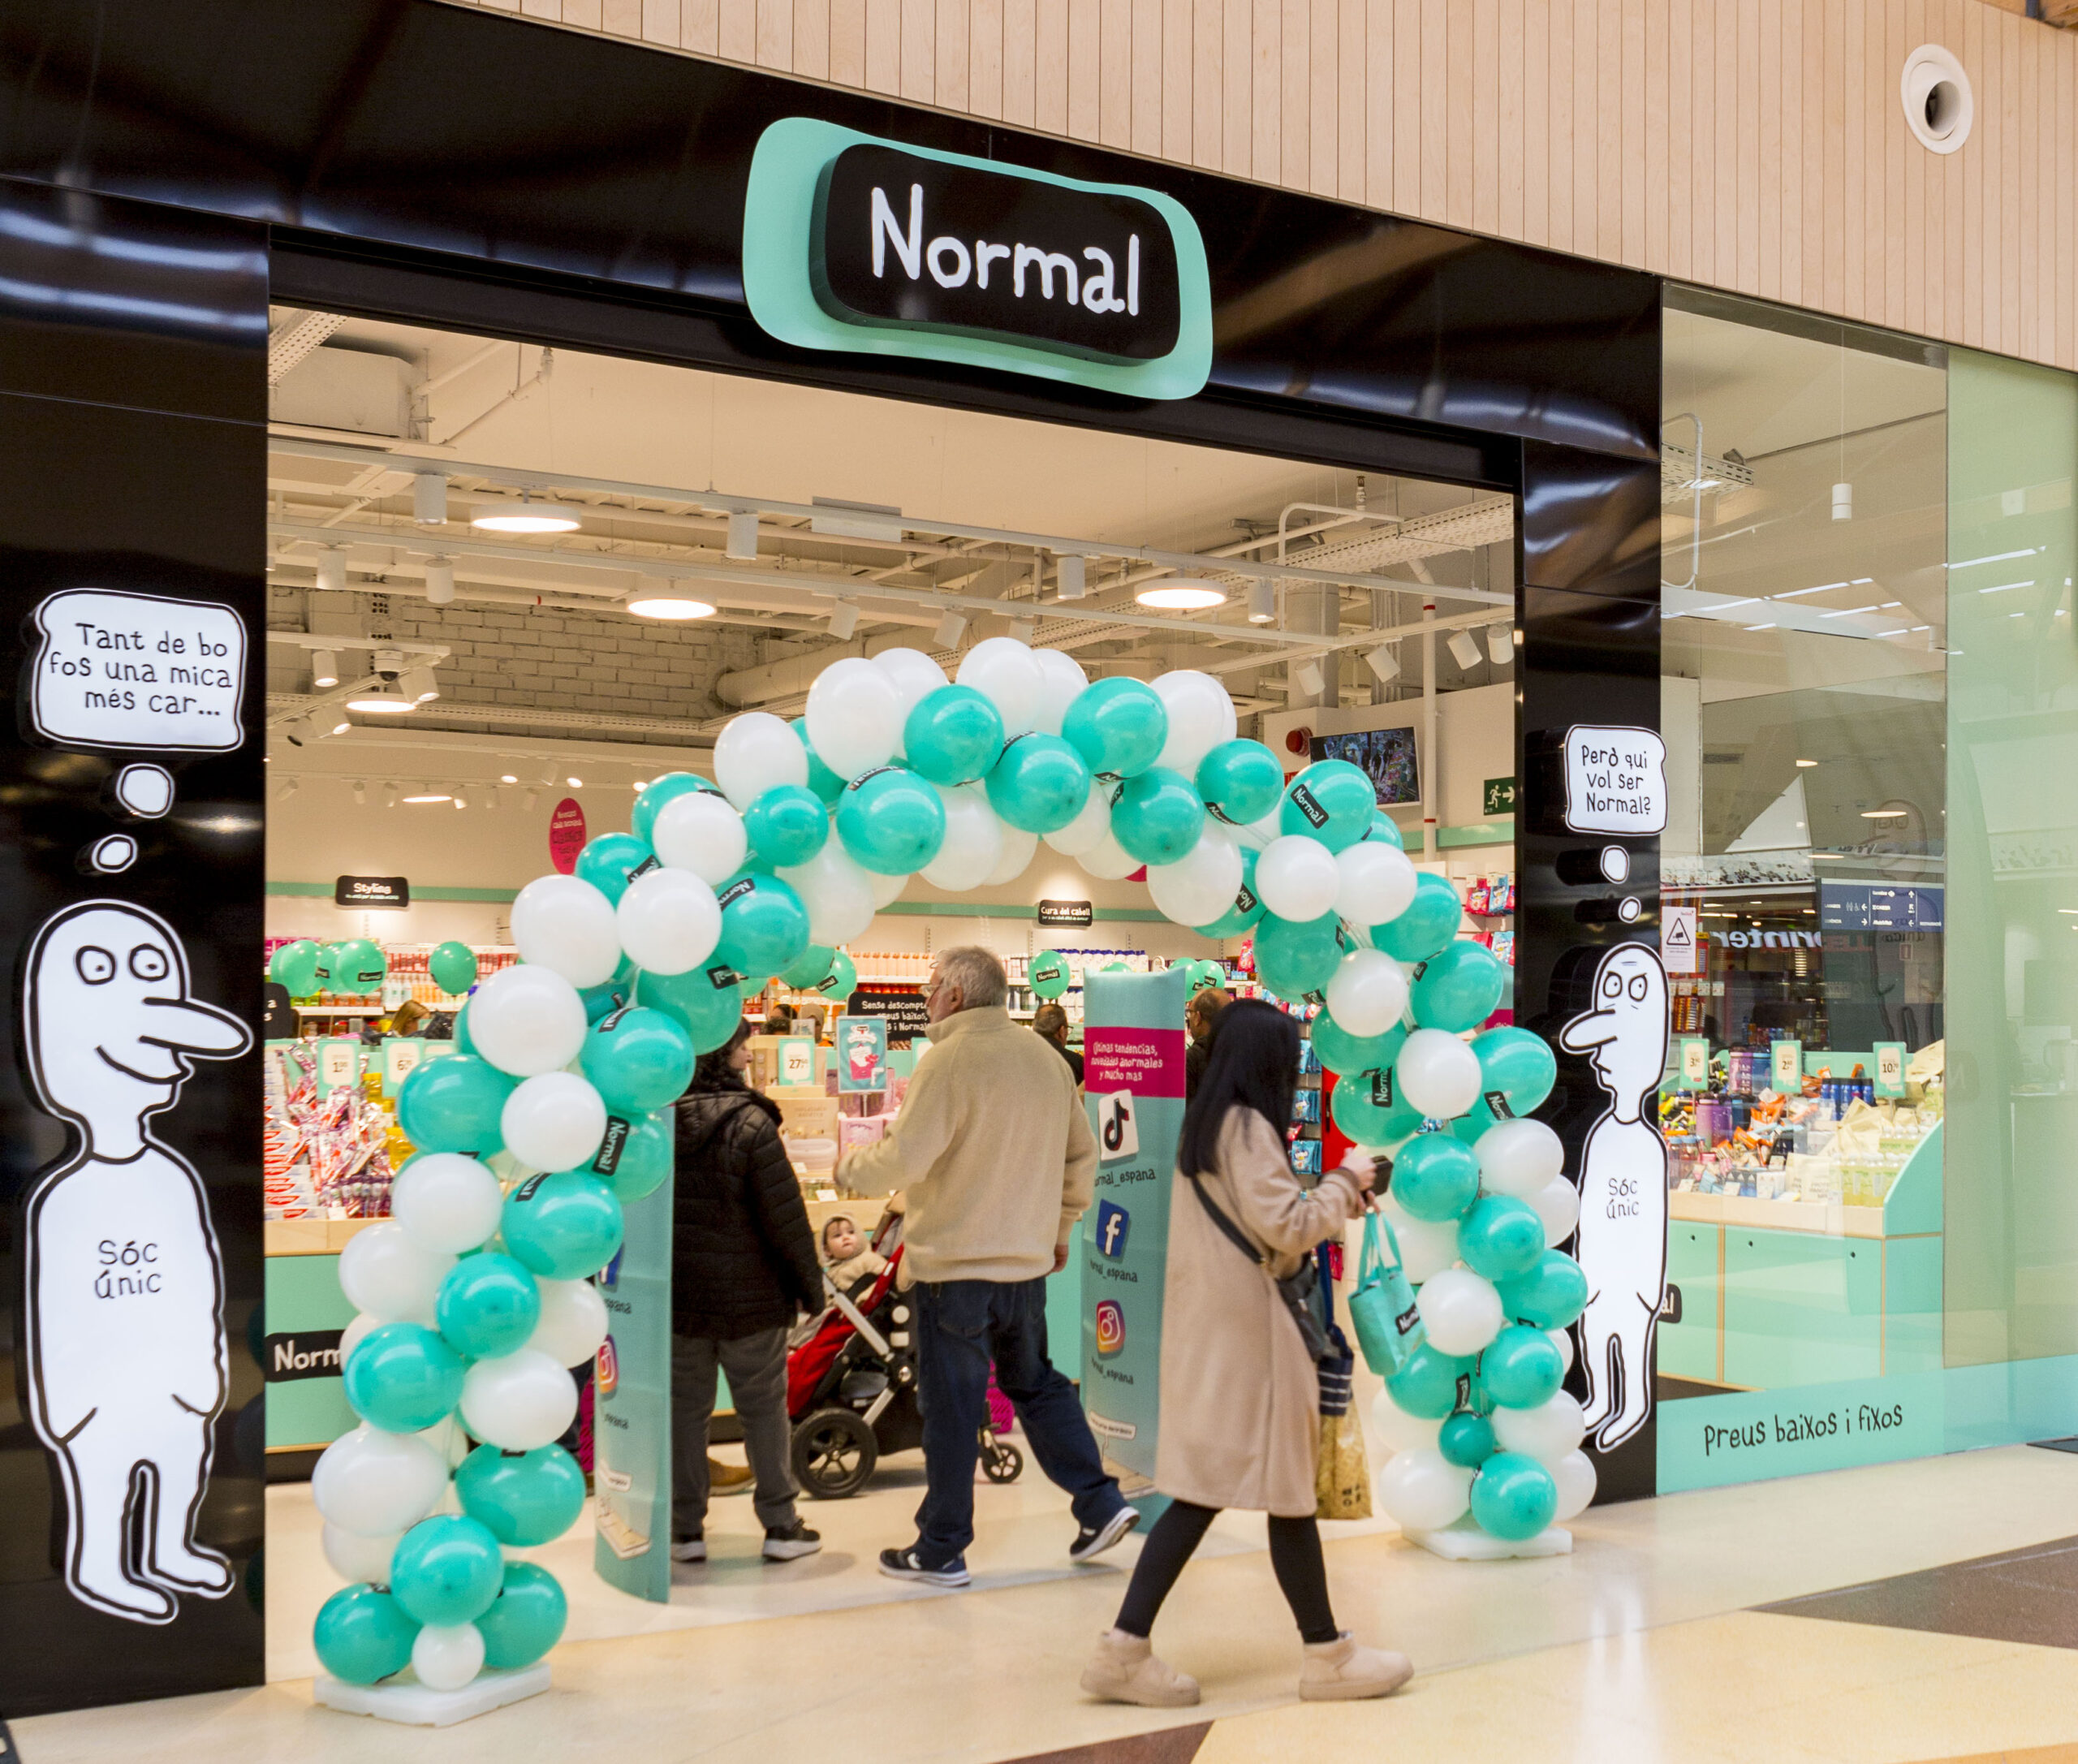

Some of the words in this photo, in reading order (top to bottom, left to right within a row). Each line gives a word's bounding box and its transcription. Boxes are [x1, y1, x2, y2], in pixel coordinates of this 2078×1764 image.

[872, 183, 1140, 317] Normal
[75, 623, 144, 650] Tant
[157, 631, 186, 653] de
[198, 632, 227, 657] bo
[50, 652, 92, 676] fos
[106, 662, 158, 683] una
[170, 666, 233, 688] mica
[85, 688, 135, 709] més
[149, 694, 221, 715] car...
[1581, 744, 1619, 767] Però
[1625, 751, 1647, 770] qui
[1587, 770, 1611, 788] vol
[1294, 787, 1324, 823] Normal
[1587, 792, 1650, 815] Normal?
[719, 881, 751, 904] Norm
[1239, 890, 1252, 908] Nor
[1041, 906, 1058, 916] Cura
[1059, 907, 1070, 916] del
[861, 1001, 886, 1010] Sense
[1114, 1043, 1158, 1056] tendencias,
[1104, 1068, 1124, 1080] mucho
[1119, 1057, 1163, 1068] anormales
[598, 1122, 626, 1171] Normal
[1609, 1178, 1637, 1196] Sóc
[1606, 1198, 1639, 1219] únic
[99, 1240, 157, 1266] Sóc
[95, 1269, 162, 1299] únic
[274, 1339, 340, 1372] Norm
[1705, 1424, 1765, 1456] preus
[1775, 1413, 1838, 1443] baixos
[1845, 1408, 1851, 1434] i
[1858, 1404, 1903, 1431] fixos
